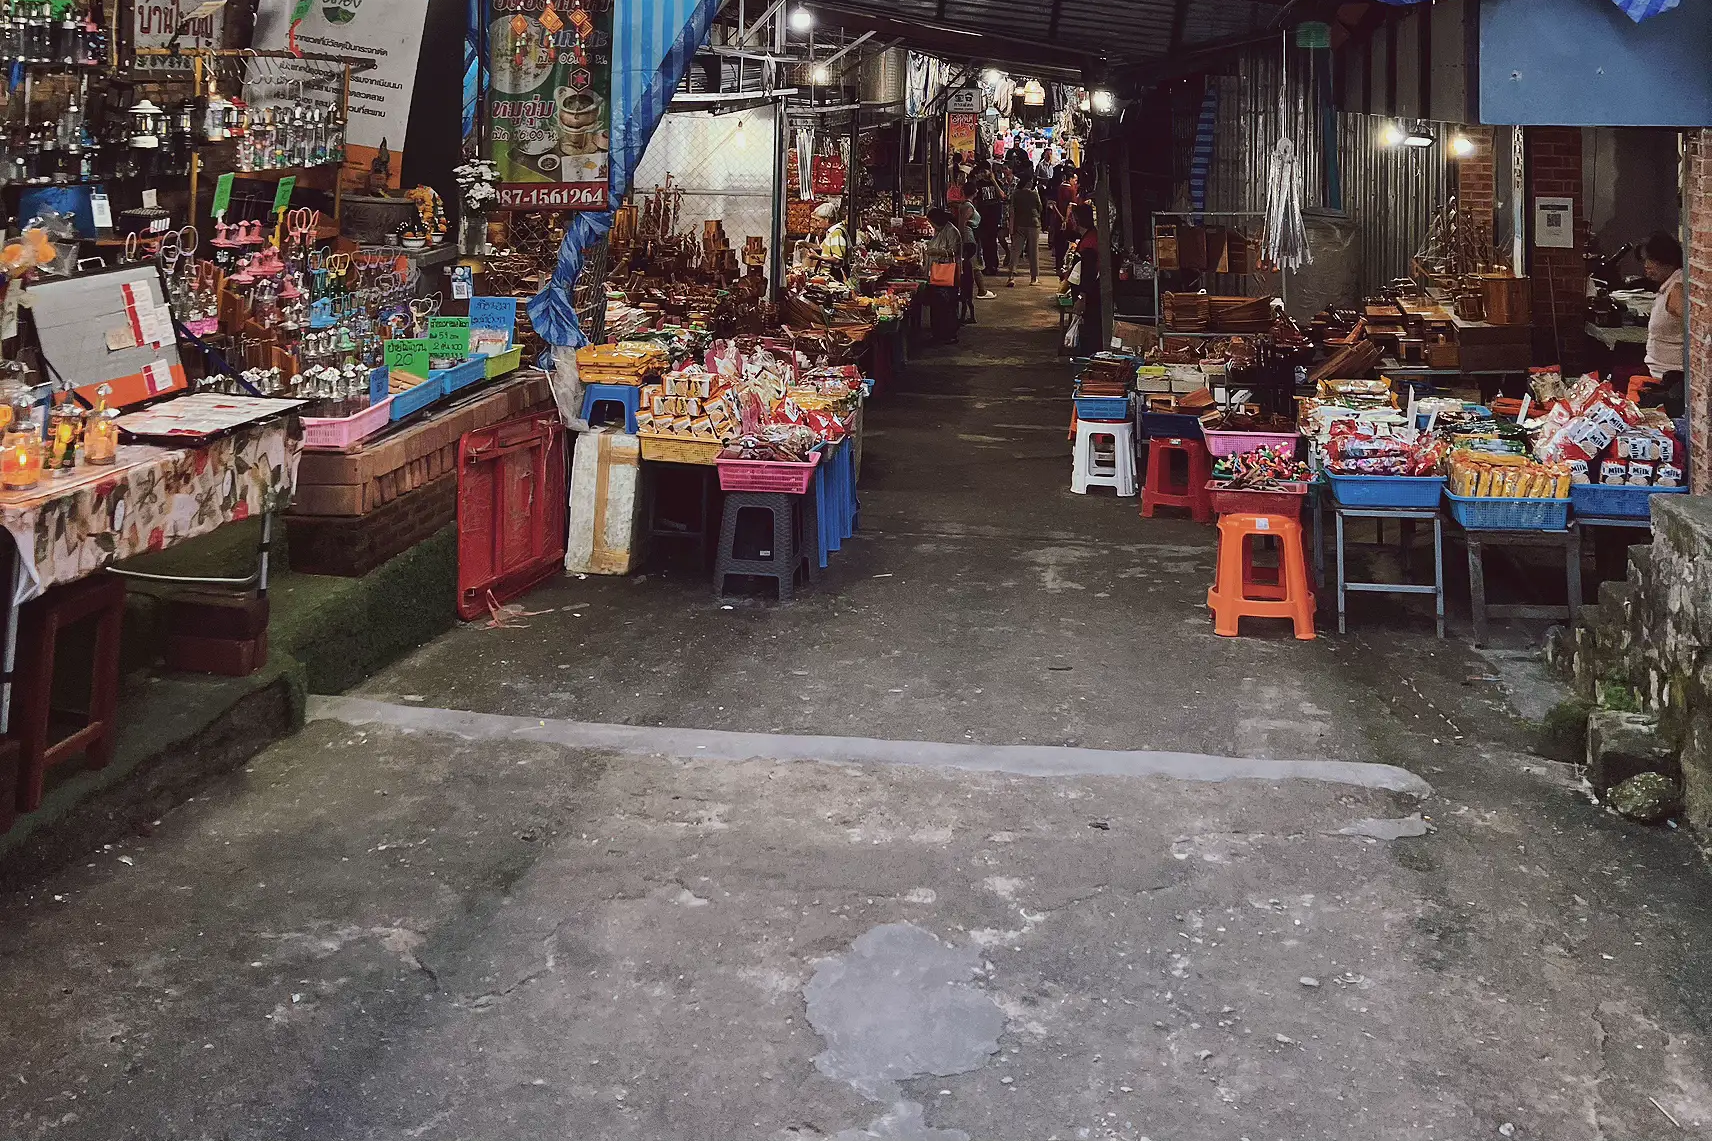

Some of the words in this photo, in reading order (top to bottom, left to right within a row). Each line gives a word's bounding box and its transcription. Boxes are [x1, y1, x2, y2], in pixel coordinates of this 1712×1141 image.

[492, 93, 556, 127] หมูจุ่ม
[393, 353, 415, 368] 20
[1608, 417, 1625, 433] Milk
[1590, 434, 1605, 448] Milk
[1607, 465, 1626, 475] Milk
[1632, 465, 1651, 476] Milk
